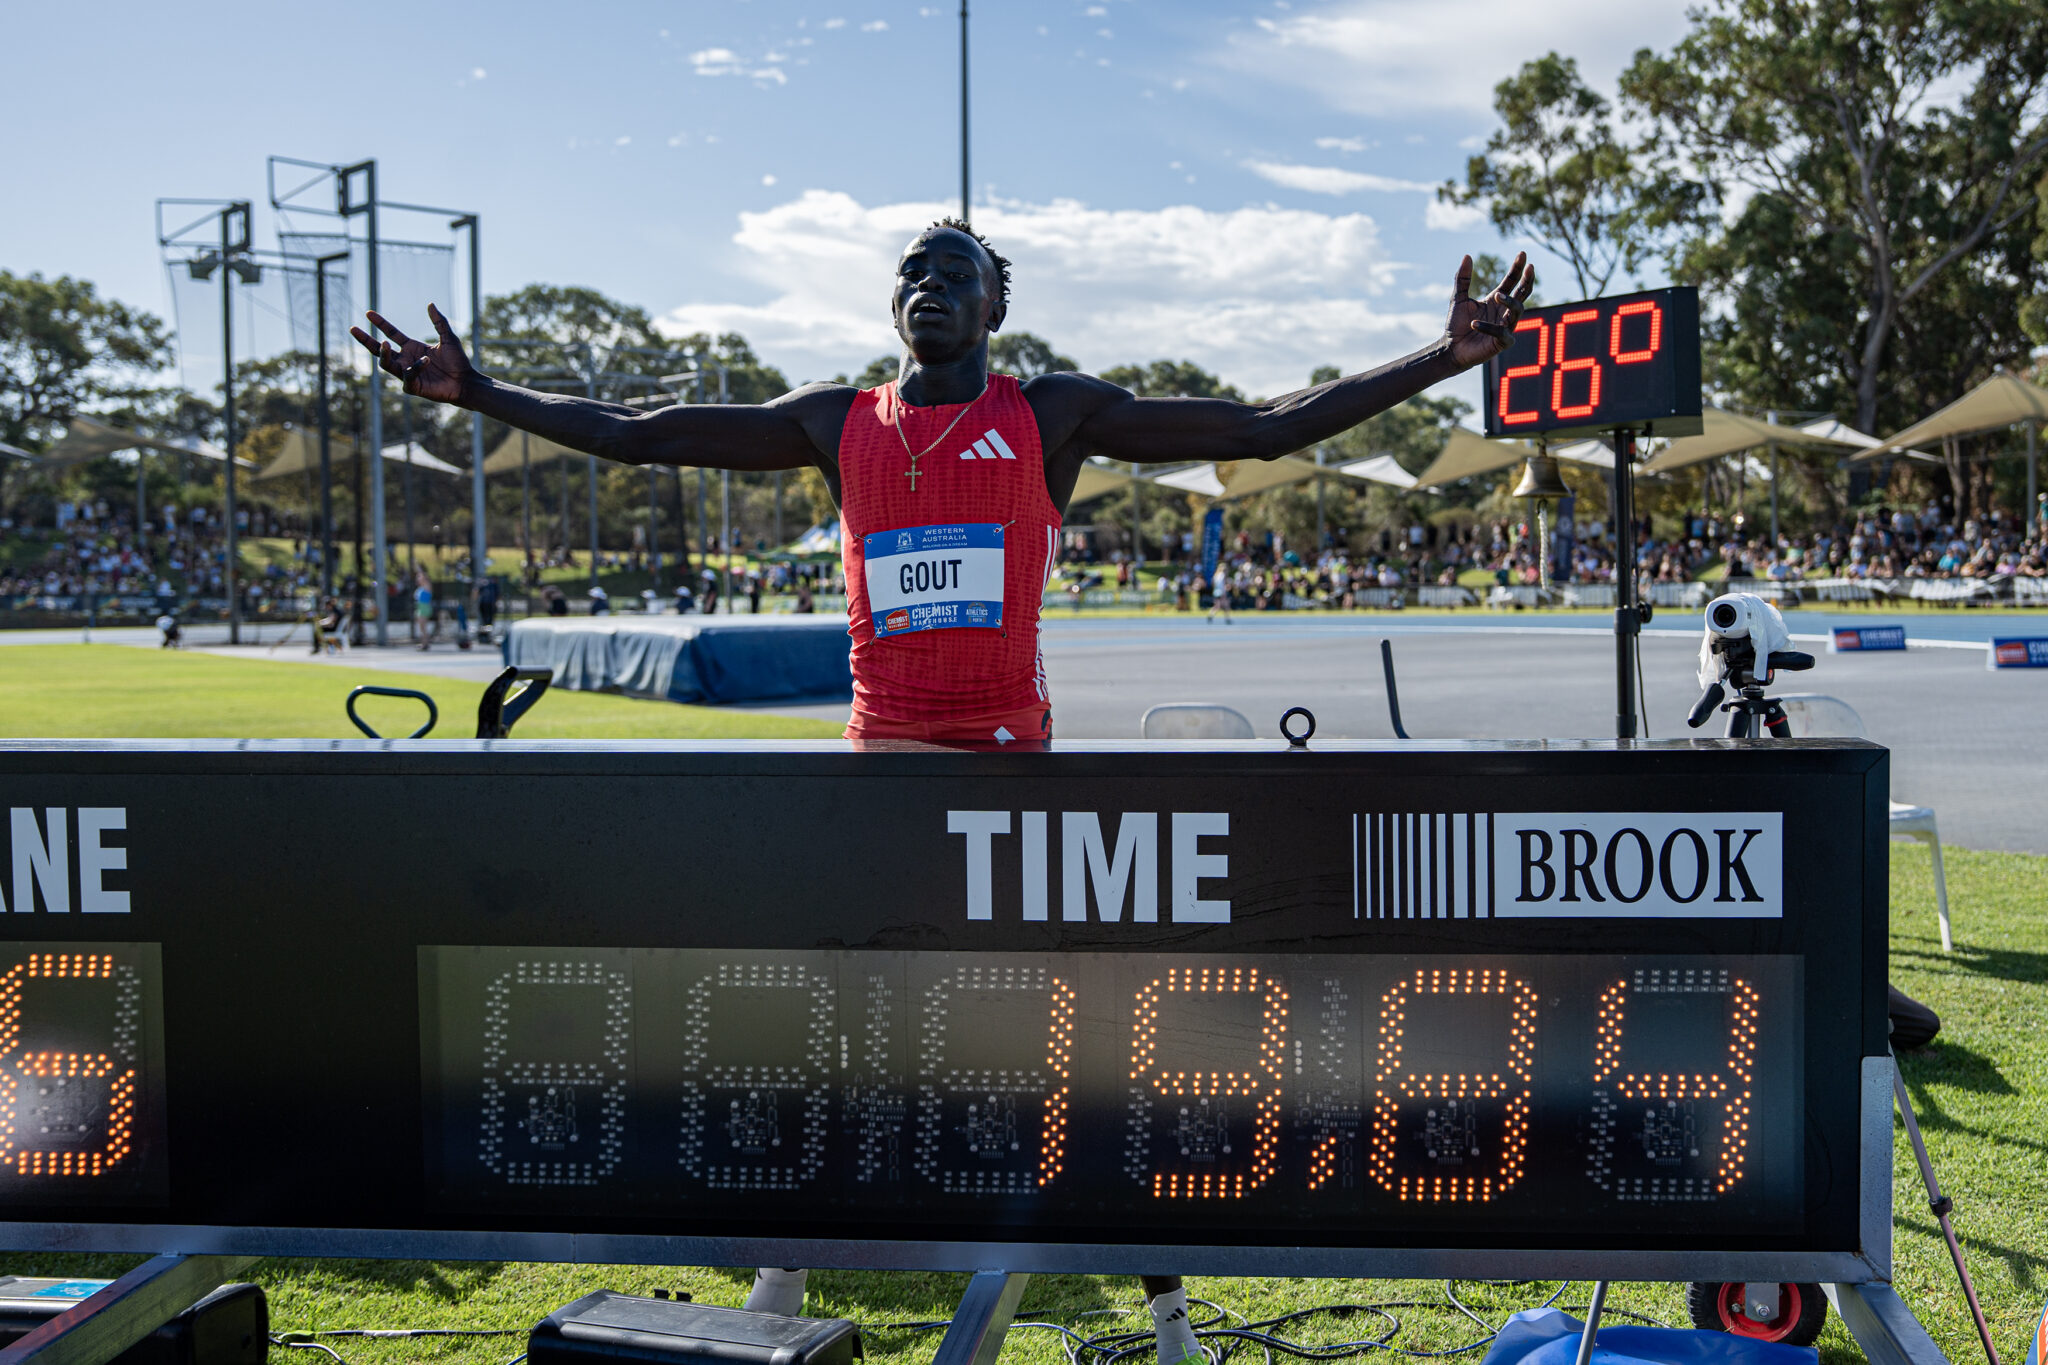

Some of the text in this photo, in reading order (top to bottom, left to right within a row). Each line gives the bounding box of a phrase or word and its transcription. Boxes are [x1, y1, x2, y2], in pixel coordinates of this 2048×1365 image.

[900, 559, 962, 594] GOUT
[912, 604, 958, 620] CHEMIST
[0, 807, 131, 912] NE
[947, 811, 1231, 923] TIME
[1515, 827, 1765, 904] BROOK
